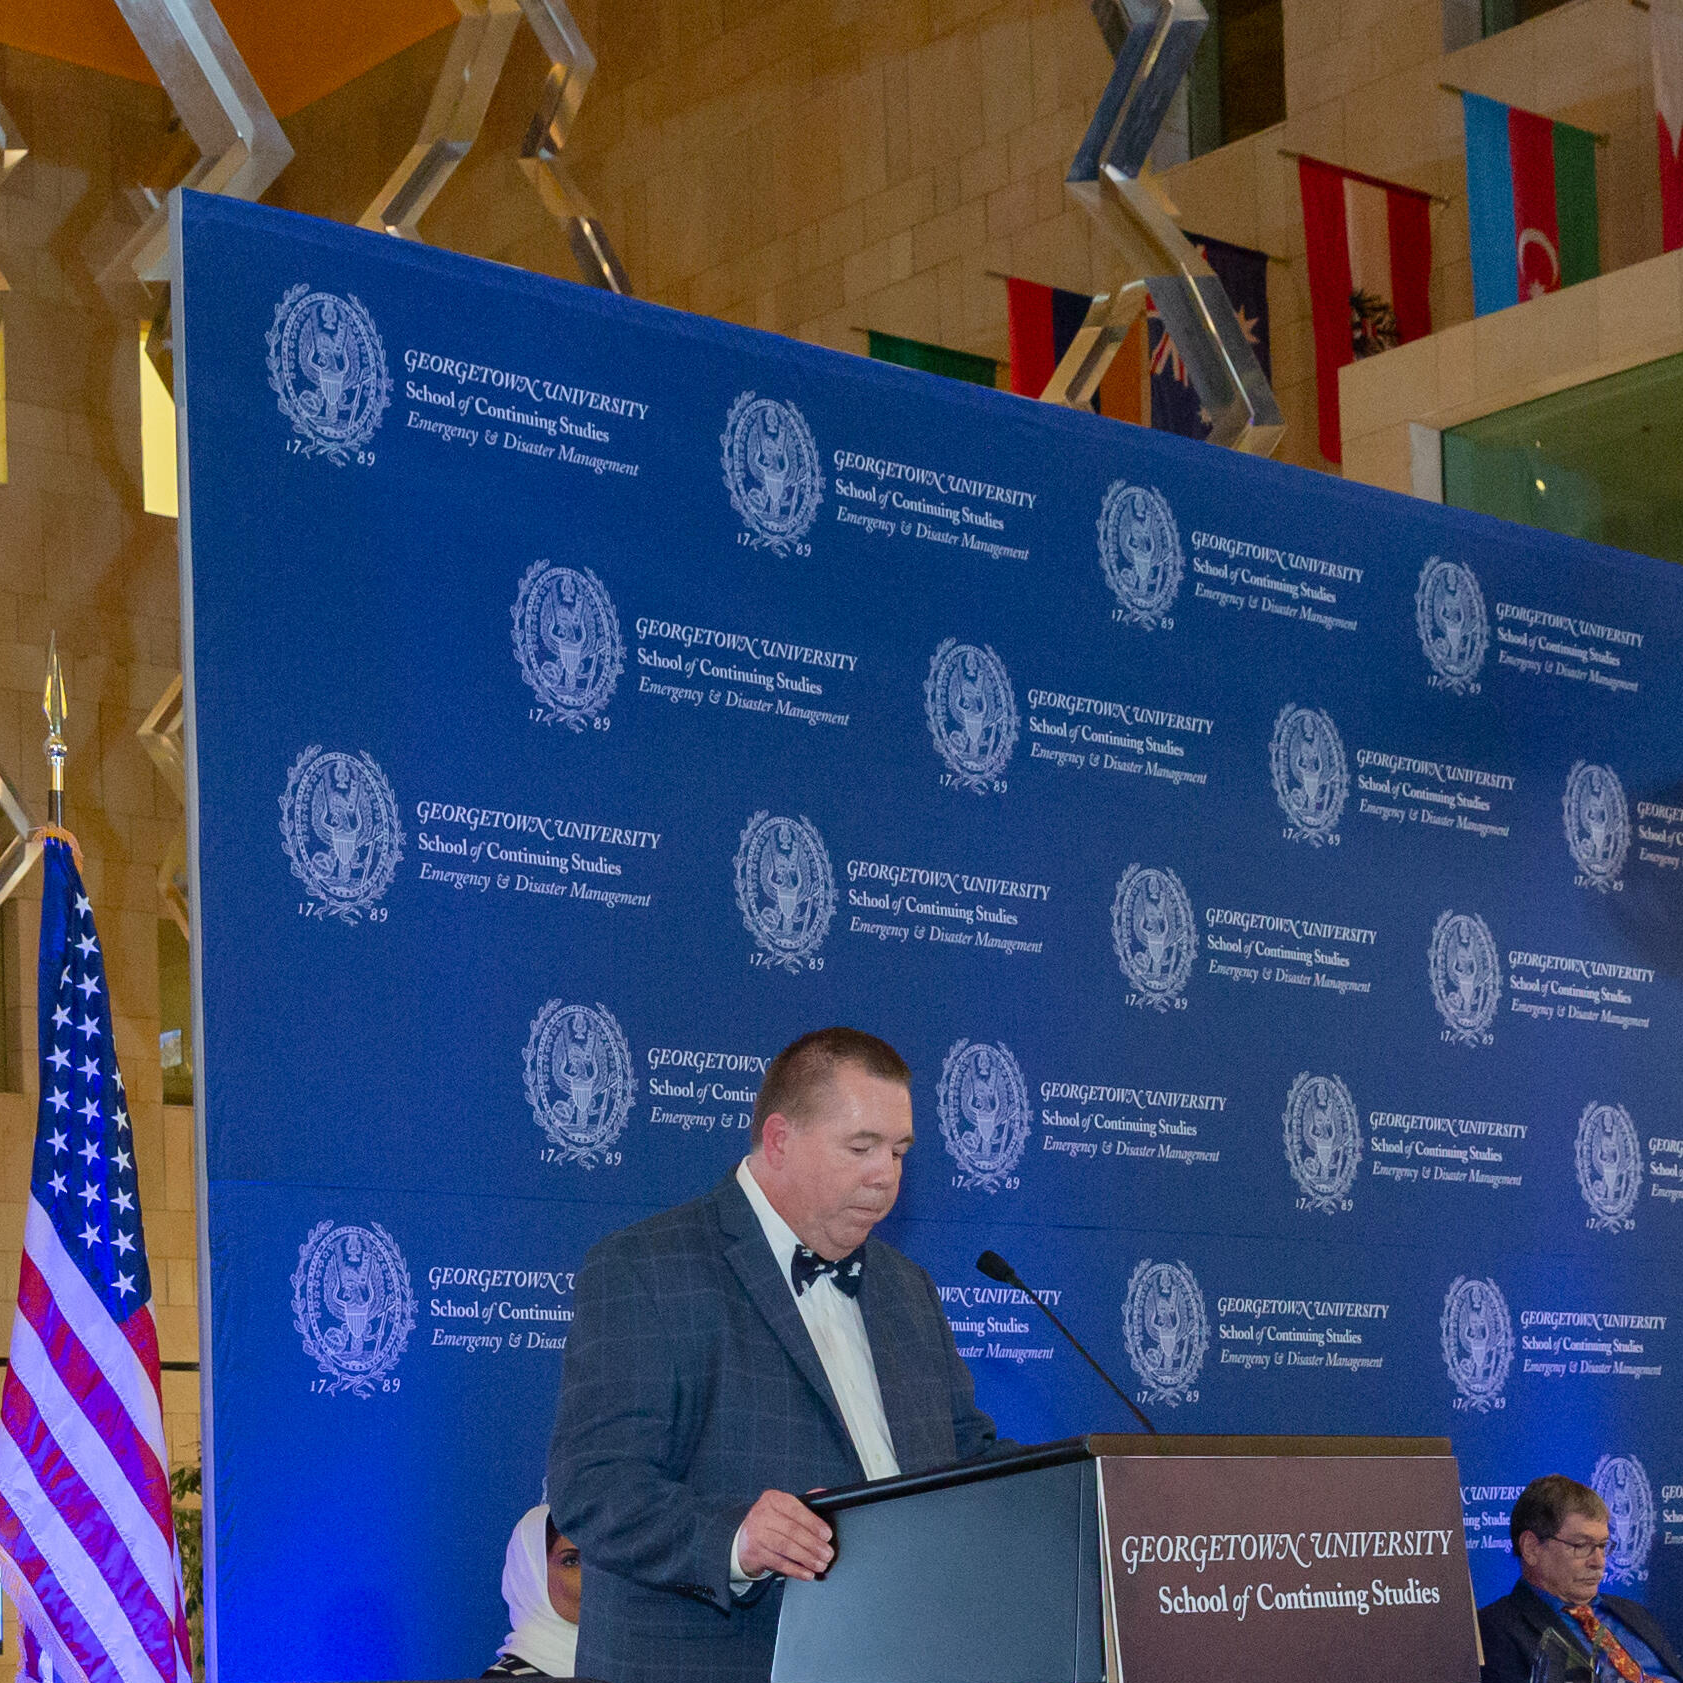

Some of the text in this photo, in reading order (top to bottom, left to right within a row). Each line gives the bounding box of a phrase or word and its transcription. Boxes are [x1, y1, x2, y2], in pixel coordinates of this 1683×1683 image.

[404, 350, 649, 420] GEORGETOWN UNIVERSITY
[406, 381, 610, 442] School of Continuing Studies
[406, 411, 639, 476] Emergency & Disaster Management
[833, 449, 1036, 509] GEORGETOWN UNIVERSITY
[835, 478, 1004, 530] School of Continuing Studies
[836, 505, 1029, 560] Emergency & Disaster Management
[1191, 531, 1363, 583] GEORGETOWN UNIVERSITY
[1193, 557, 1336, 603] School of Continuing Studies
[635, 617, 858, 671] GEORGETOWN UNIVERSITY
[637, 647, 822, 695] School of Continuing Studies
[638, 676, 849, 726] Emergency & Disaster Management
[1027, 688, 1214, 734] GEORGETOWN UNIVERSITY
[1029, 716, 1184, 756] School of Continuing Studies
[1030, 742, 1207, 785] Emergency & Disaster Management
[416, 801, 661, 849] GEORGETOWN UNIVERSITY
[418, 832, 621, 875] School of Continuing Studies
[419, 863, 651, 908] Emergency & Disaster Management
[847, 860, 1050, 901] GEORGETOWN UNIVERSITY
[848, 888, 1018, 925] School of Continuing Studies
[849, 916, 1043, 955] Emergency & Disaster Management
[648, 1047, 771, 1075] GEORGETOWN
[649, 1077, 757, 1104] School of Contin
[1040, 1081, 1227, 1111] GEORGETOWN UNIVERSITY
[650, 1106, 733, 1132] Emergency &
[1042, 1109, 1197, 1137] School of Continuing Studies
[1042, 1135, 1220, 1165] Emergency & Disaster Management
[428, 1267, 565, 1295] GEORGETOWN
[430, 1298, 574, 1324] School of Continuin
[986, 1316, 1030, 1333] Studies
[1217, 1297, 1389, 1320] GEORGETOWN UNIVERSITY
[1520, 1310, 1667, 1331] GEORGETOWN UNIVERSITY
[431, 1329, 567, 1353] Emergency & Disast
[985, 1342, 1054, 1364] Management
[1219, 1323, 1362, 1347] School of Continuing Studies
[1522, 1335, 1644, 1356] School of Continuing Studies
[1220, 1349, 1383, 1371] Emergency & Disaster Management
[1481, 1511, 1511, 1526] Studie
[1122, 1530, 1453, 1574] GEORGETOWN UNIVERSITY
[1159, 1578, 1440, 1621] School of Continuing Studies
